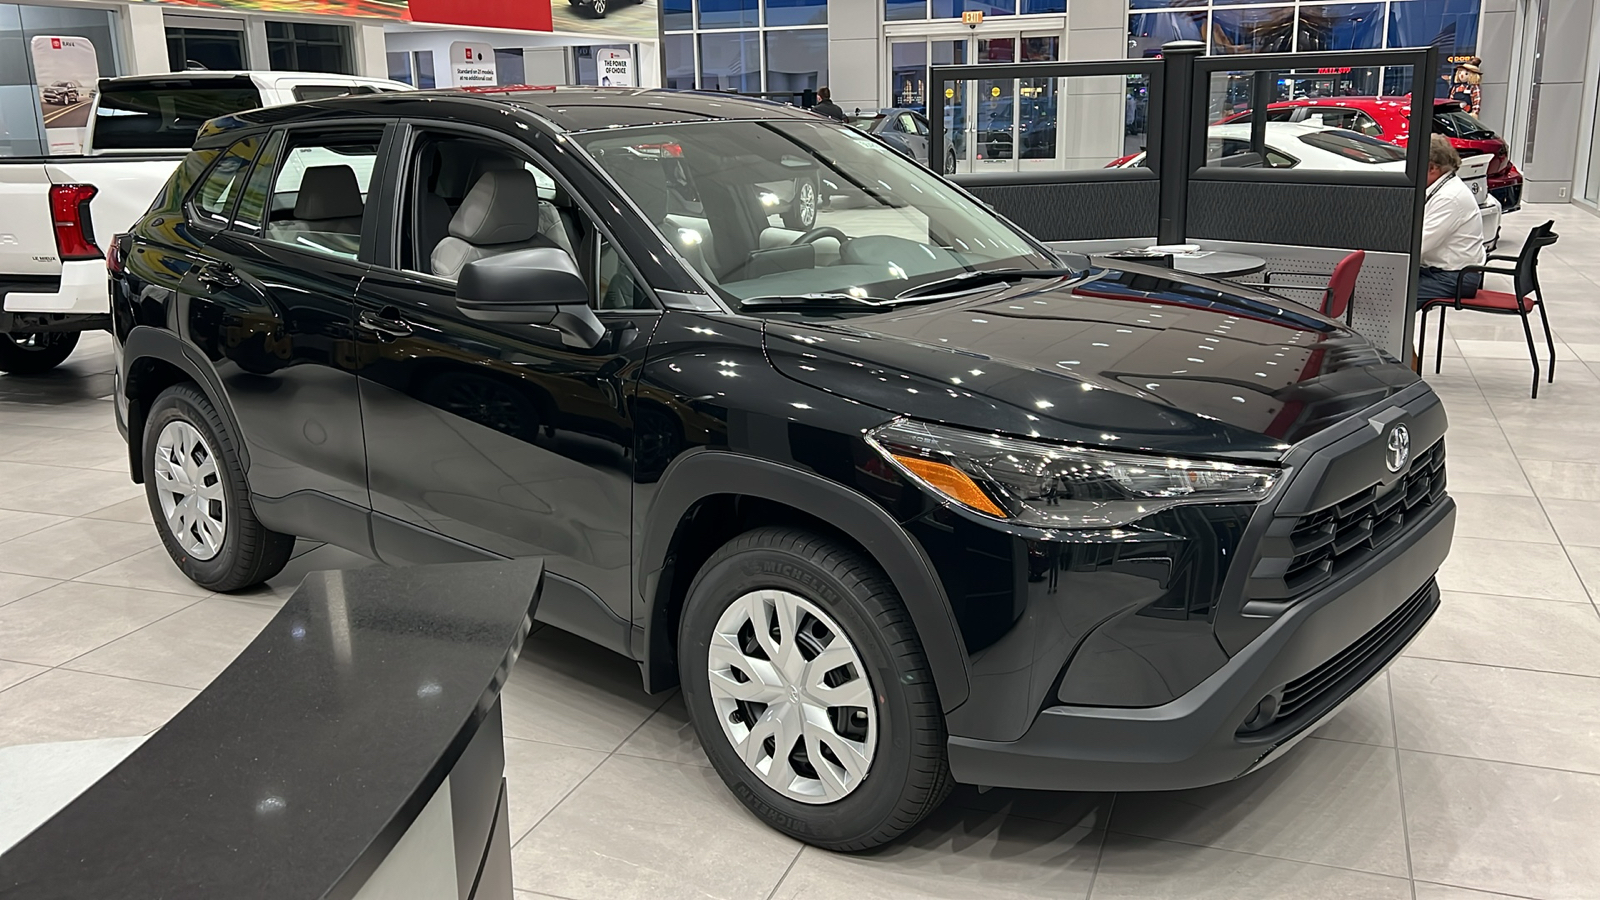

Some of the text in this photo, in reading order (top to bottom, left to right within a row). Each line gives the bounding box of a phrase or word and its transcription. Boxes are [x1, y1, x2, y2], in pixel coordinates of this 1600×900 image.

[966, 12, 979, 22] EXIT
[764, 561, 838, 602] MICHELIN
[737, 785, 806, 833] MICHELIN
